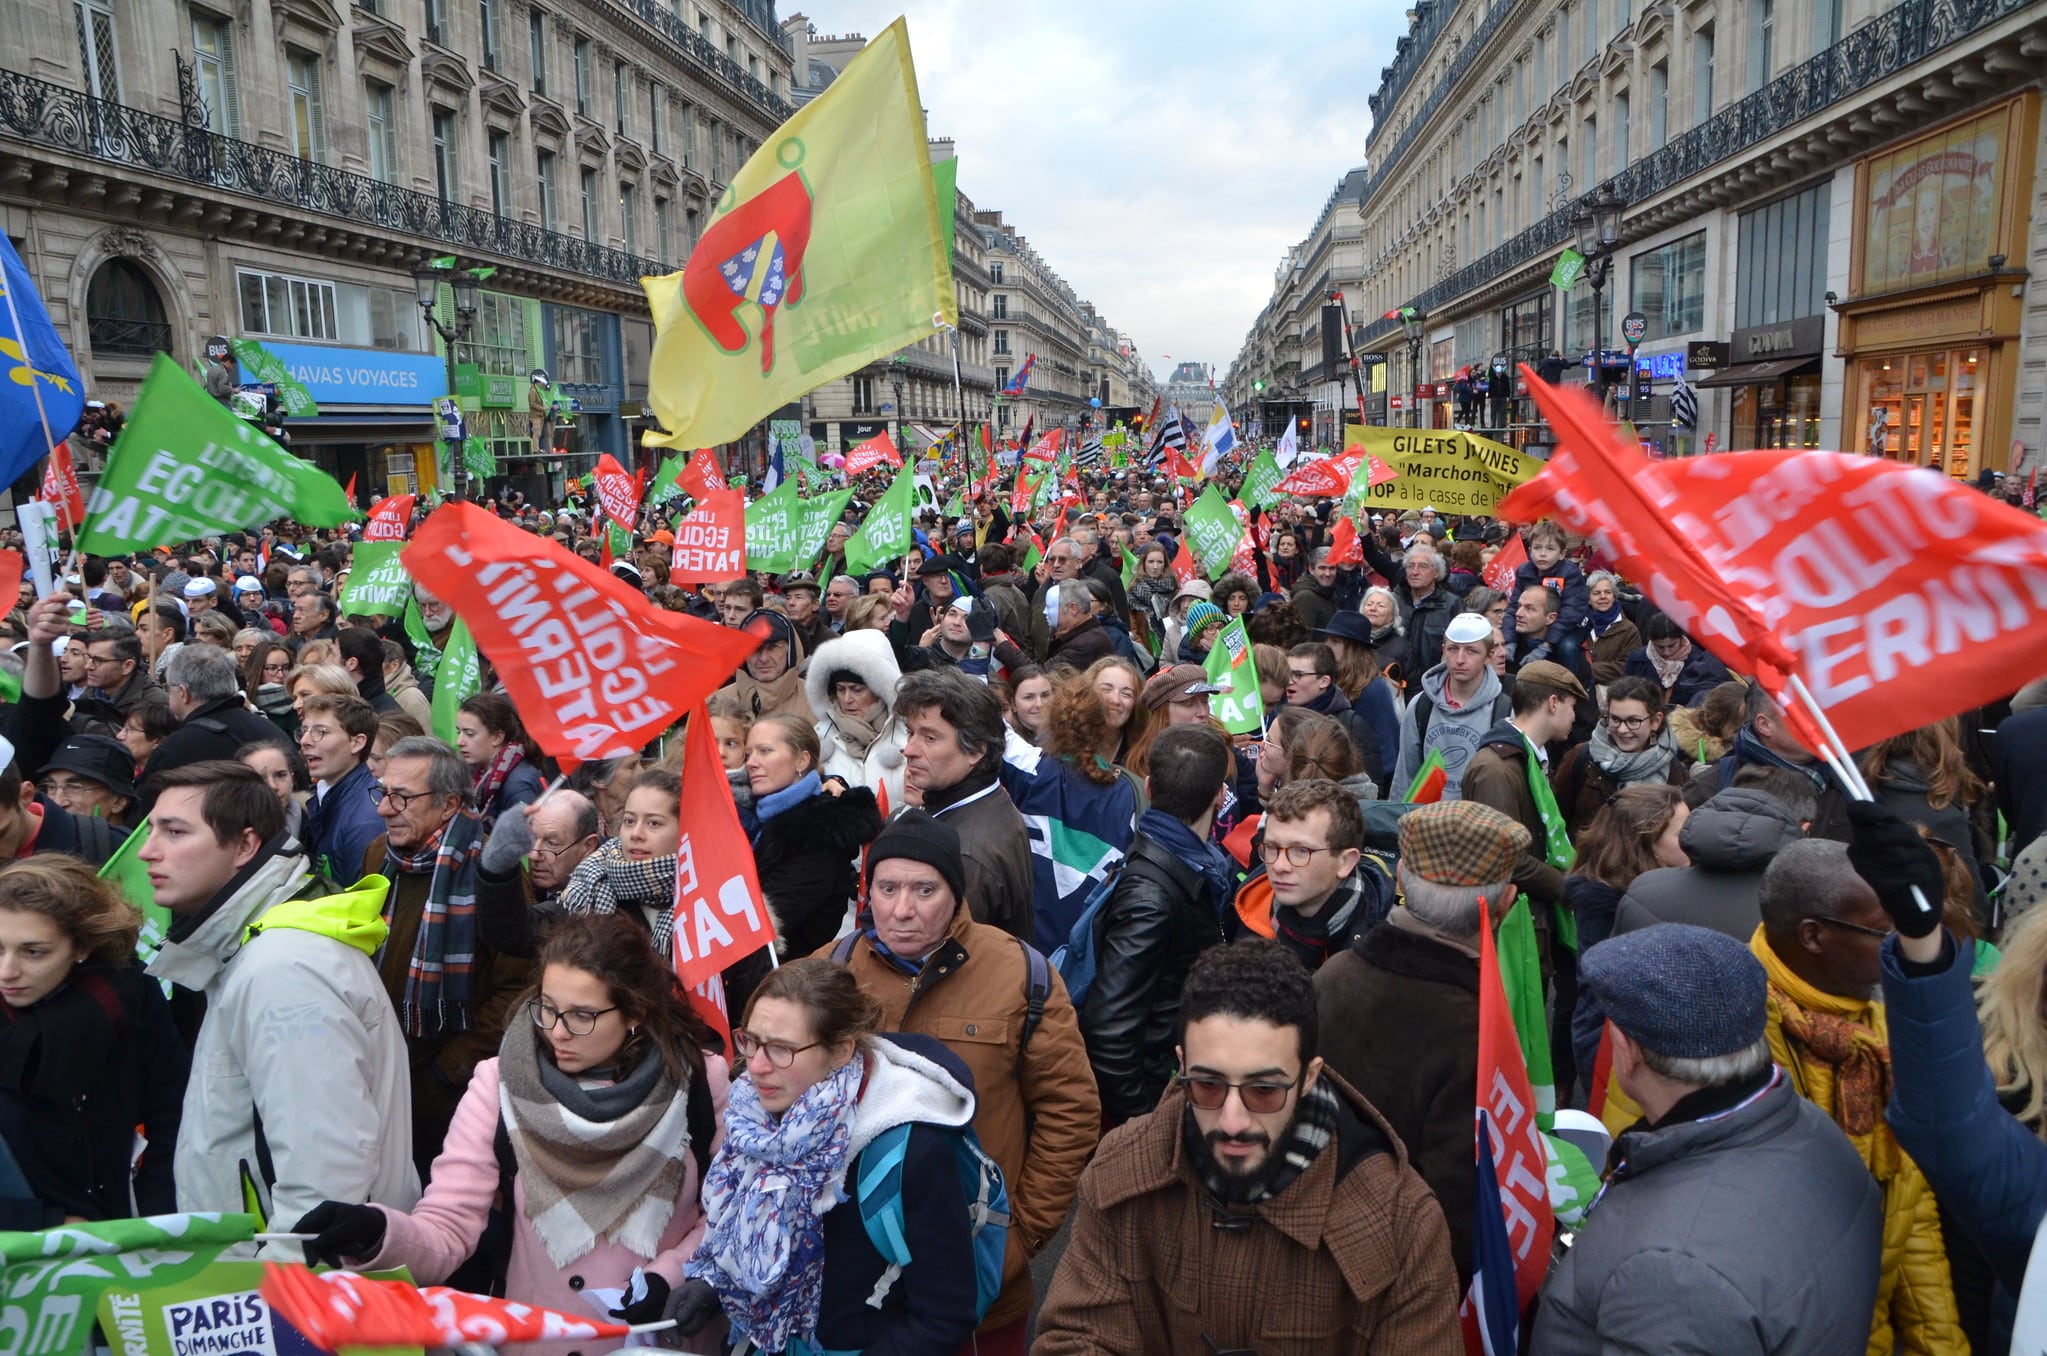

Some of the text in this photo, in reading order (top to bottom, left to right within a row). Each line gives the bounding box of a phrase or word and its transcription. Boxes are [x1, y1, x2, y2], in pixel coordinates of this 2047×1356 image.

[208, 344, 228, 356] BUS
[1493, 357, 1506, 365] BUS
[283, 364, 417, 388] HAVAS VOYAGES
[1393, 436, 1457, 455] GILETS
[1400, 463, 1490, 483] "Marchons
[1400, 485, 1408, 499] à
[1412, 487, 1424, 501] la
[1429, 490, 1465, 506] casse
[1471, 489, 1488, 506] de
[1447, 726, 1471, 738] RUGBY
[175, 1326, 266, 1356] DIMANCHE
